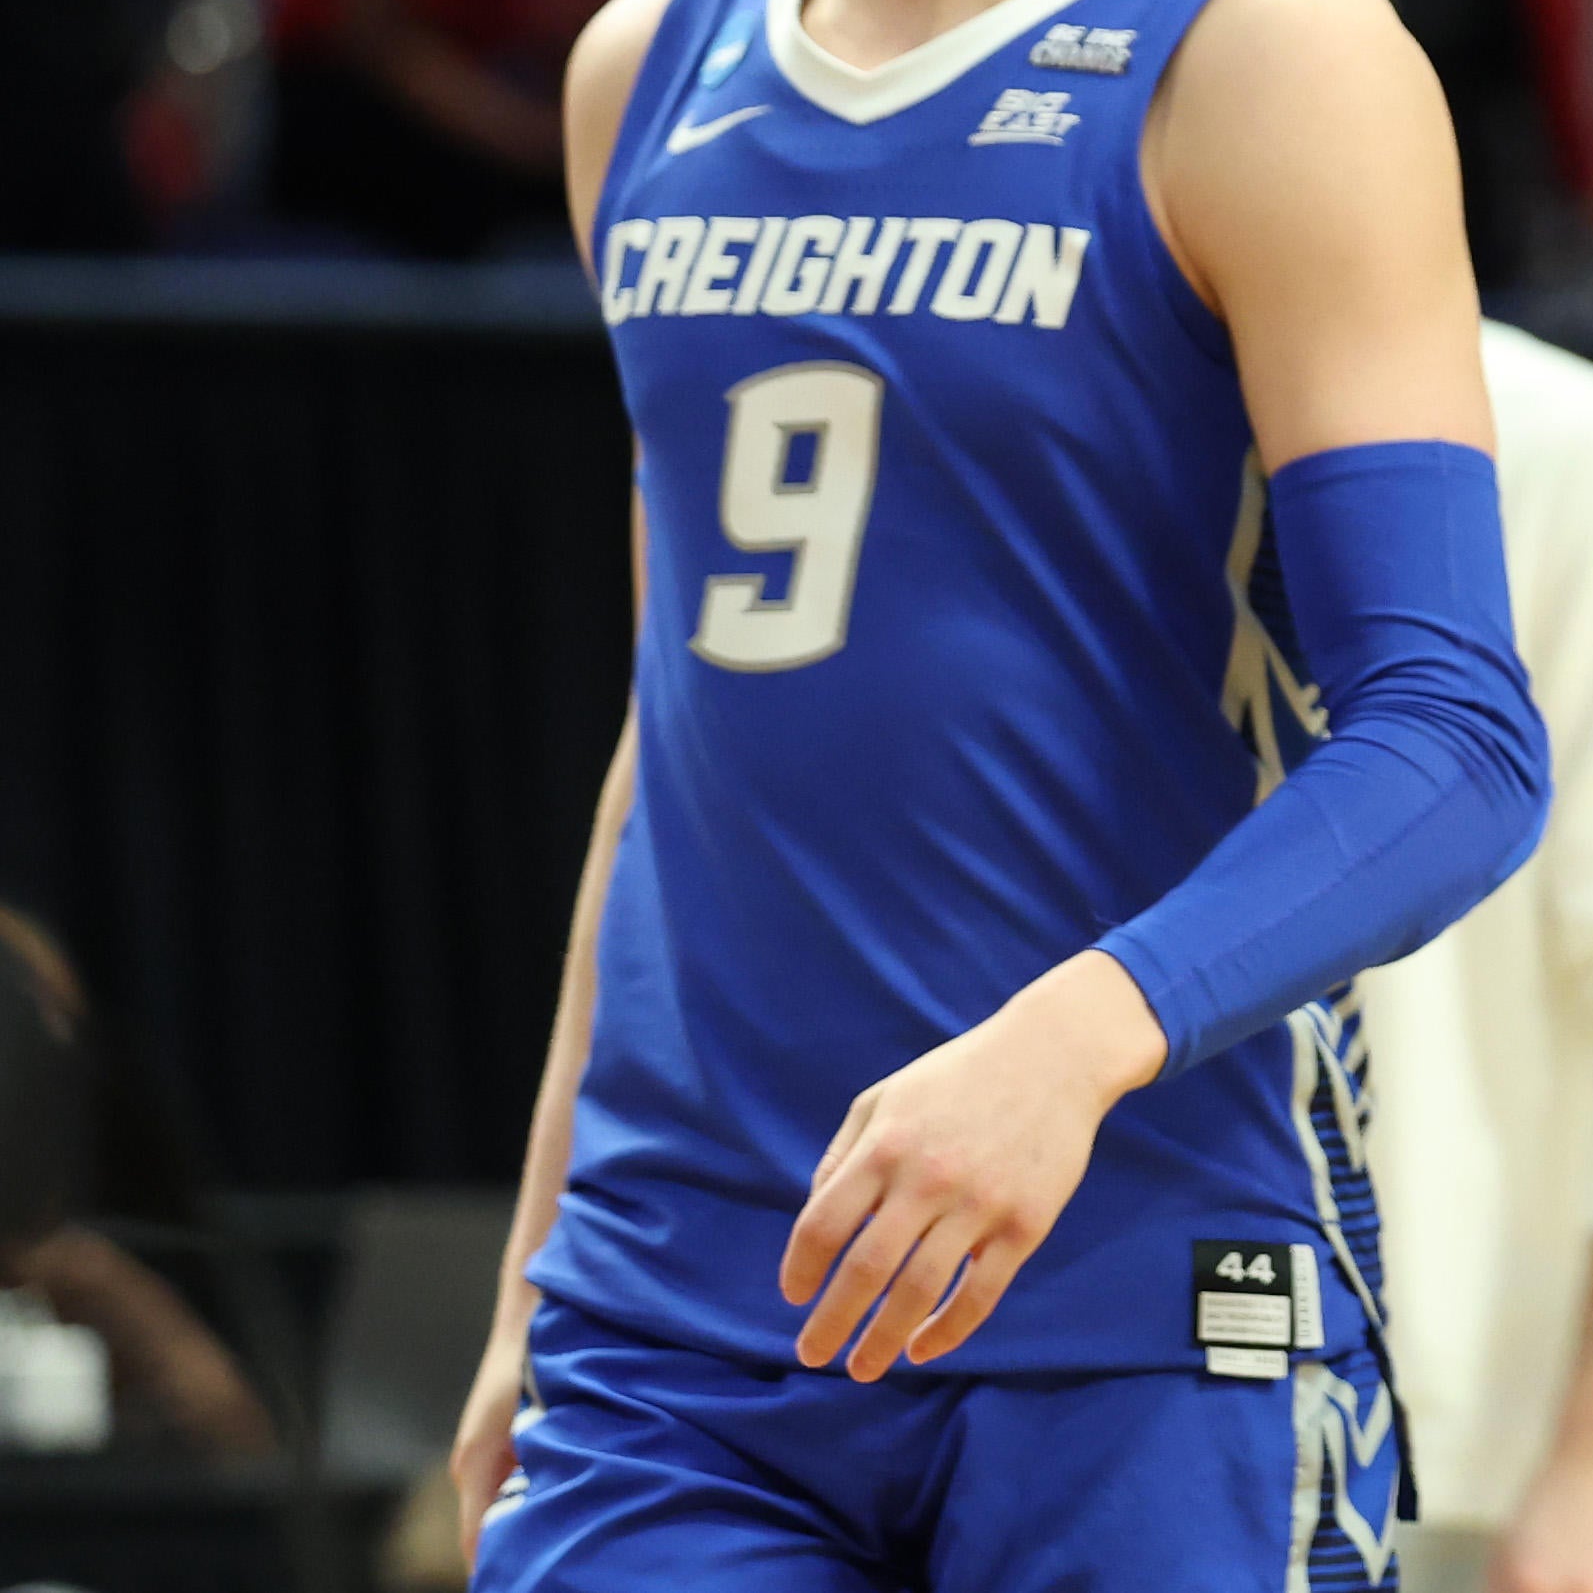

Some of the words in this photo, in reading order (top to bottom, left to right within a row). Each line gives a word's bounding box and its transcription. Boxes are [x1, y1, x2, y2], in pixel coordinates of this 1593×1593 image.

[602, 215, 1091, 330] CREIGHTON
[688, 360, 885, 672] 9
[1215, 1251, 1277, 1286] 44
